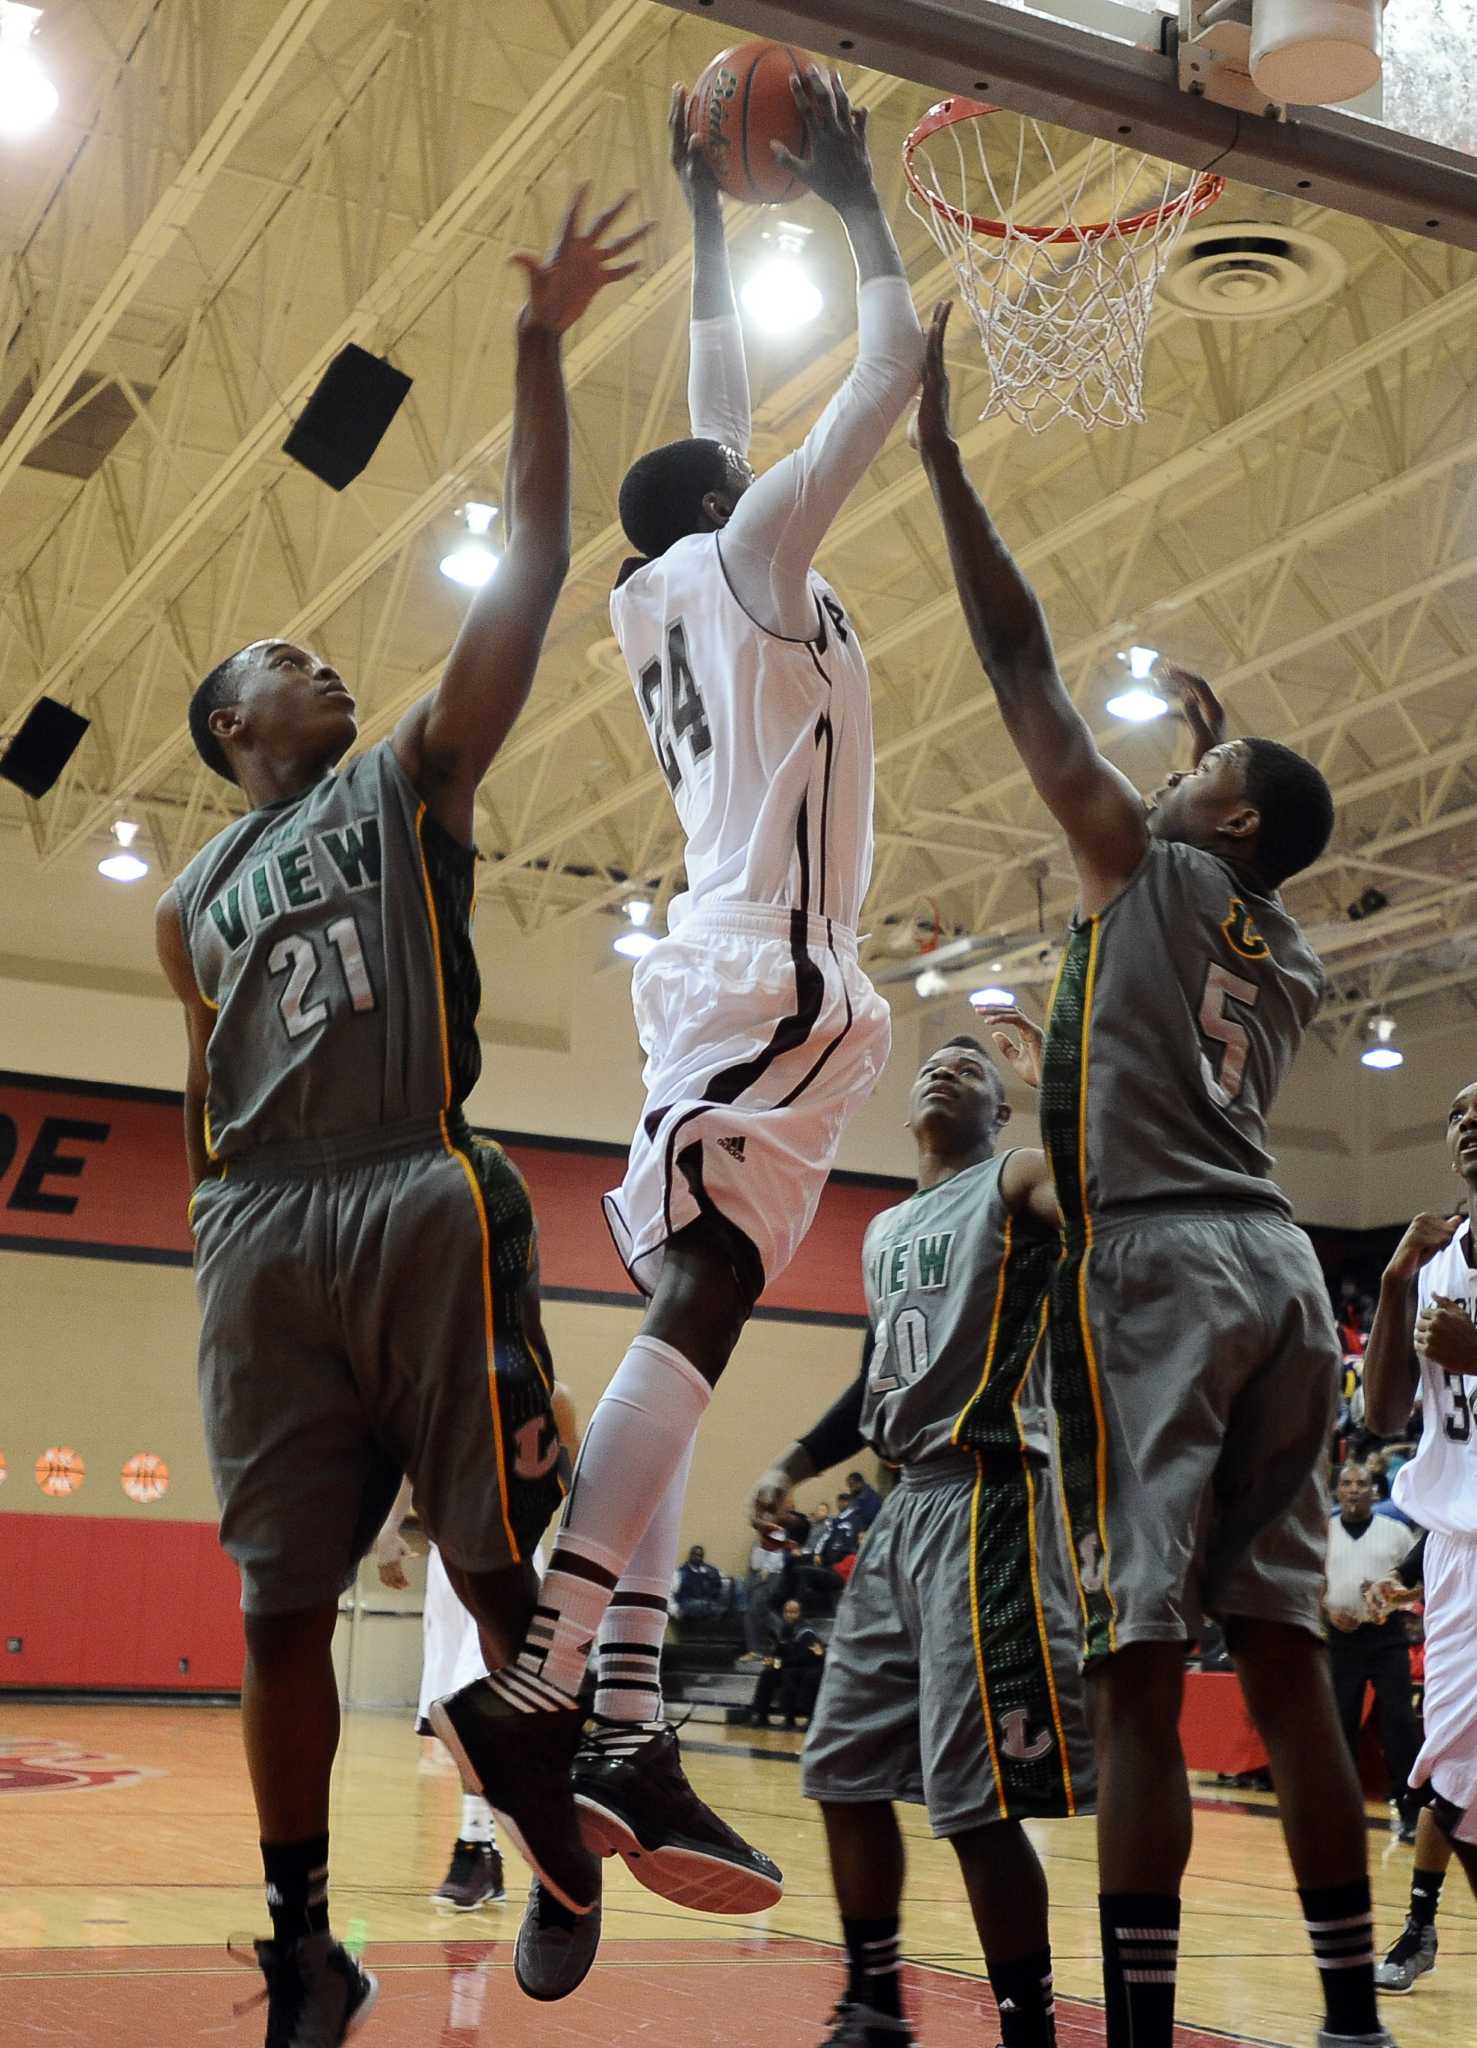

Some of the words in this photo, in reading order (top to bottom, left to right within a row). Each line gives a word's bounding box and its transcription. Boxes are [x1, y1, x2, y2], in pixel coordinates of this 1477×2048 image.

[206, 813, 385, 955] VIEW
[267, 917, 377, 1040] 21
[1199, 960, 1260, 1108] 5
[0, 1113, 112, 1216] E
[868, 1306, 931, 1395] 20
